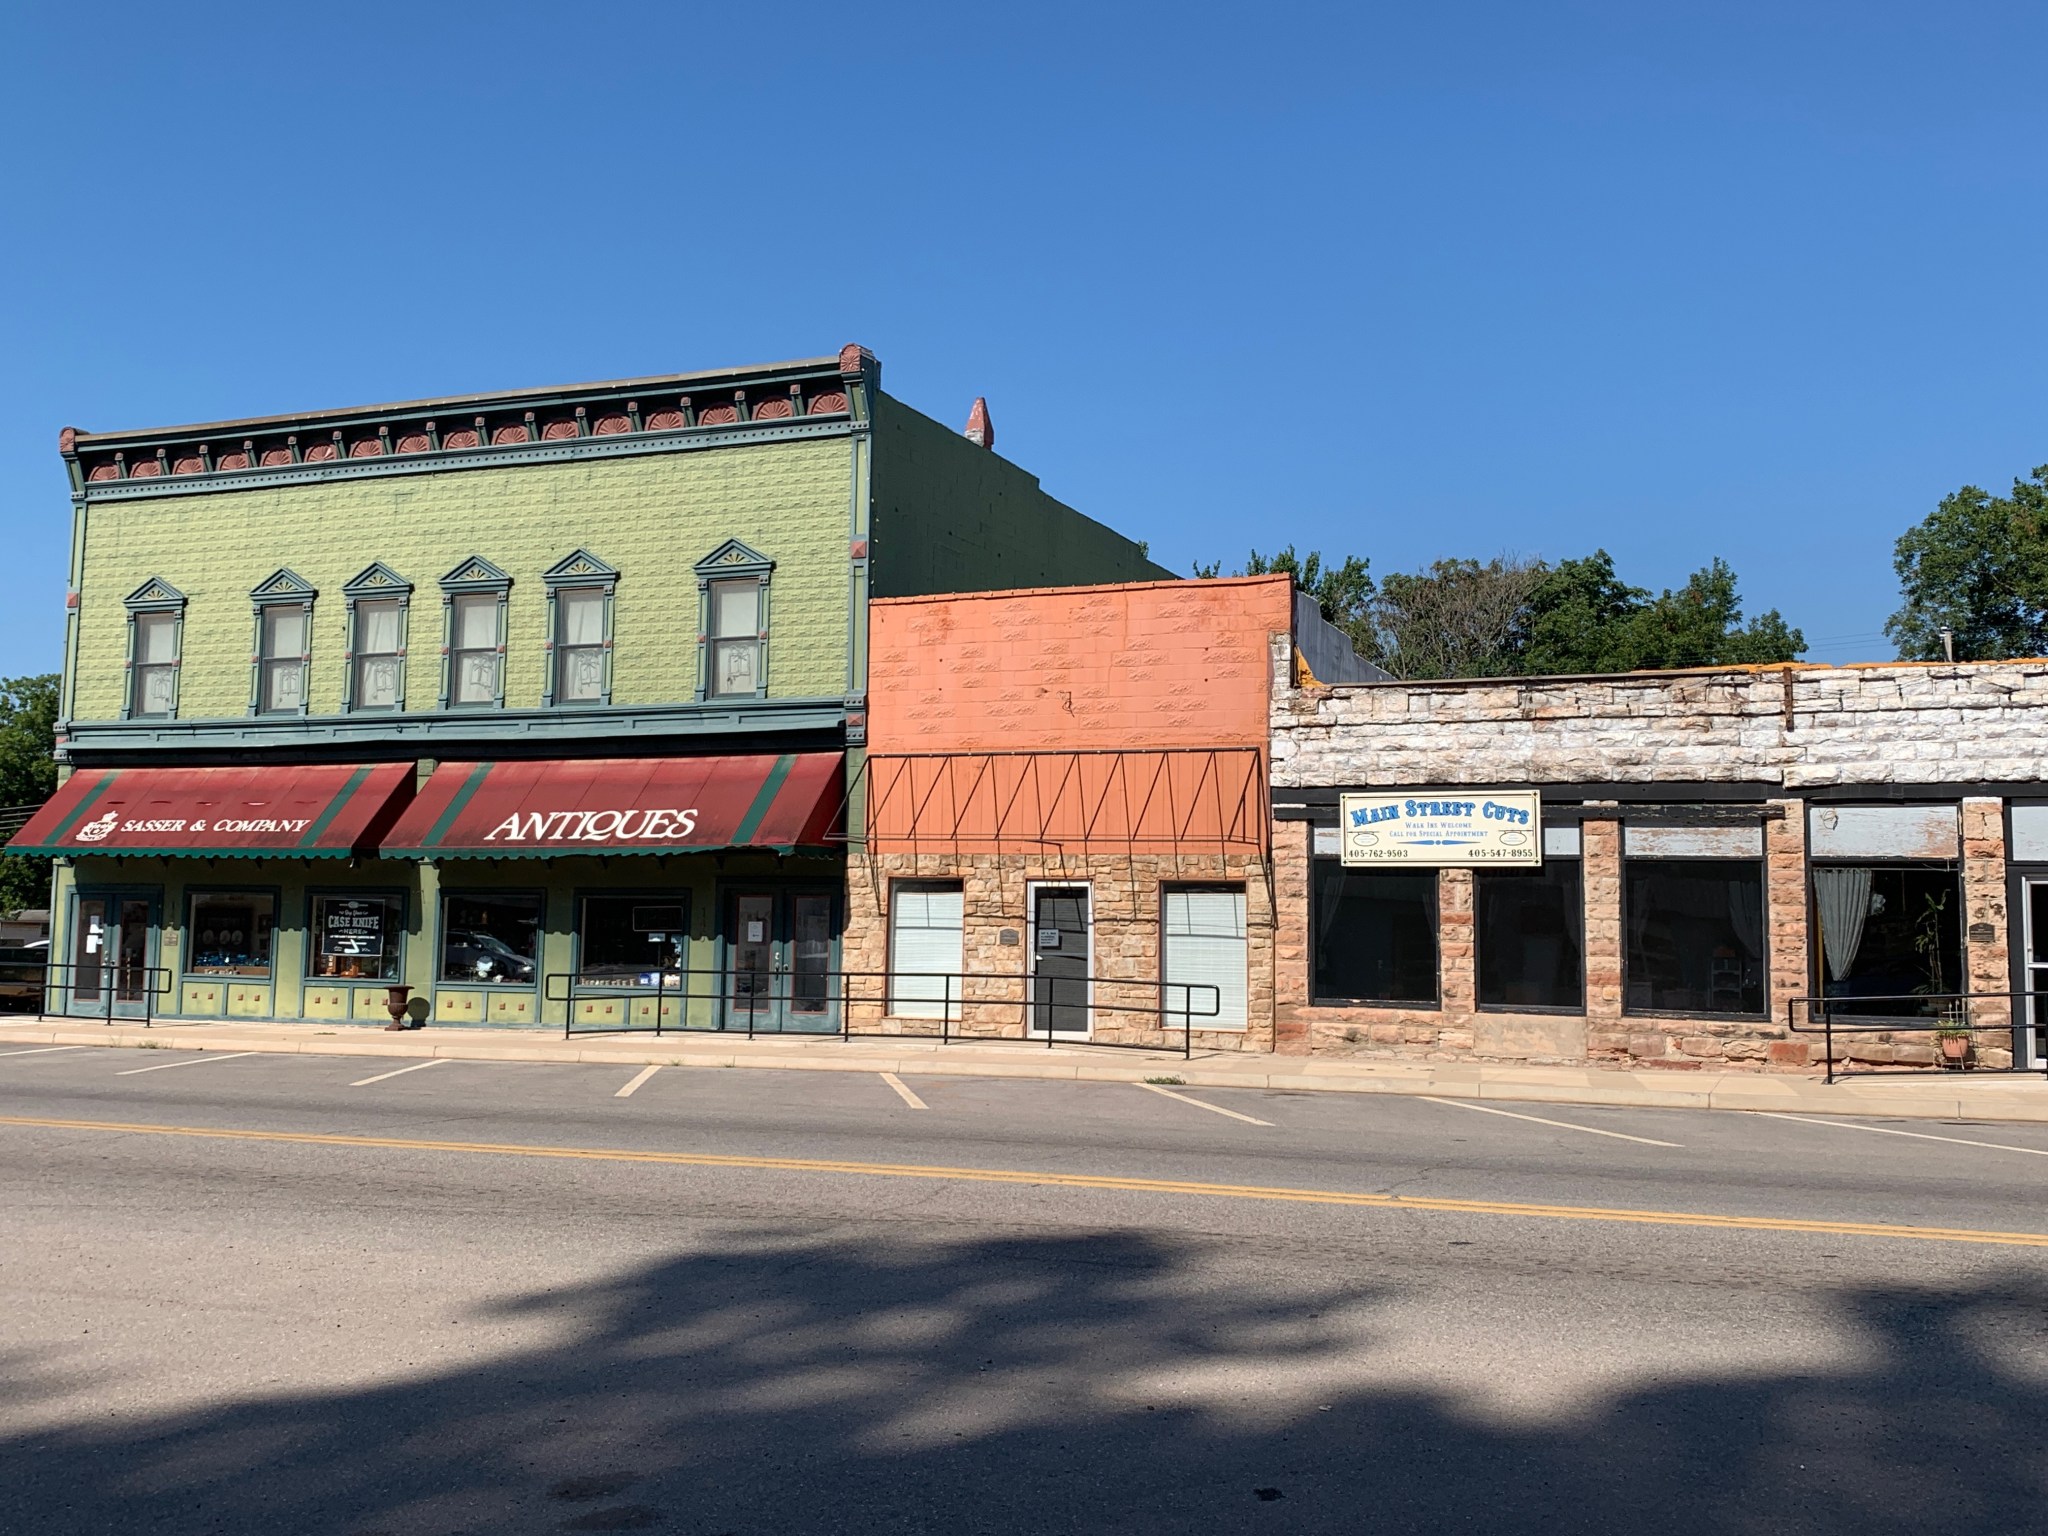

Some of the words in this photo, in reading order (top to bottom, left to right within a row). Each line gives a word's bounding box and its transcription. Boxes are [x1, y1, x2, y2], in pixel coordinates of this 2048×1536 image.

[1350, 804, 1400, 828] MAIN
[1405, 800, 1476, 818] STREET
[1482, 801, 1530, 825] CUTS
[120, 819, 184, 832] SASSER
[189, 819, 207, 832] &
[213, 819, 311, 832] COMPANY
[483, 808, 698, 841] ANTIQUES
[1348, 849, 1409, 858] 405-762-9503
[1468, 849, 1533, 858] 405-547-8955
[328, 914, 351, 928] CASE
[352, 916, 379, 930] KNIFE
